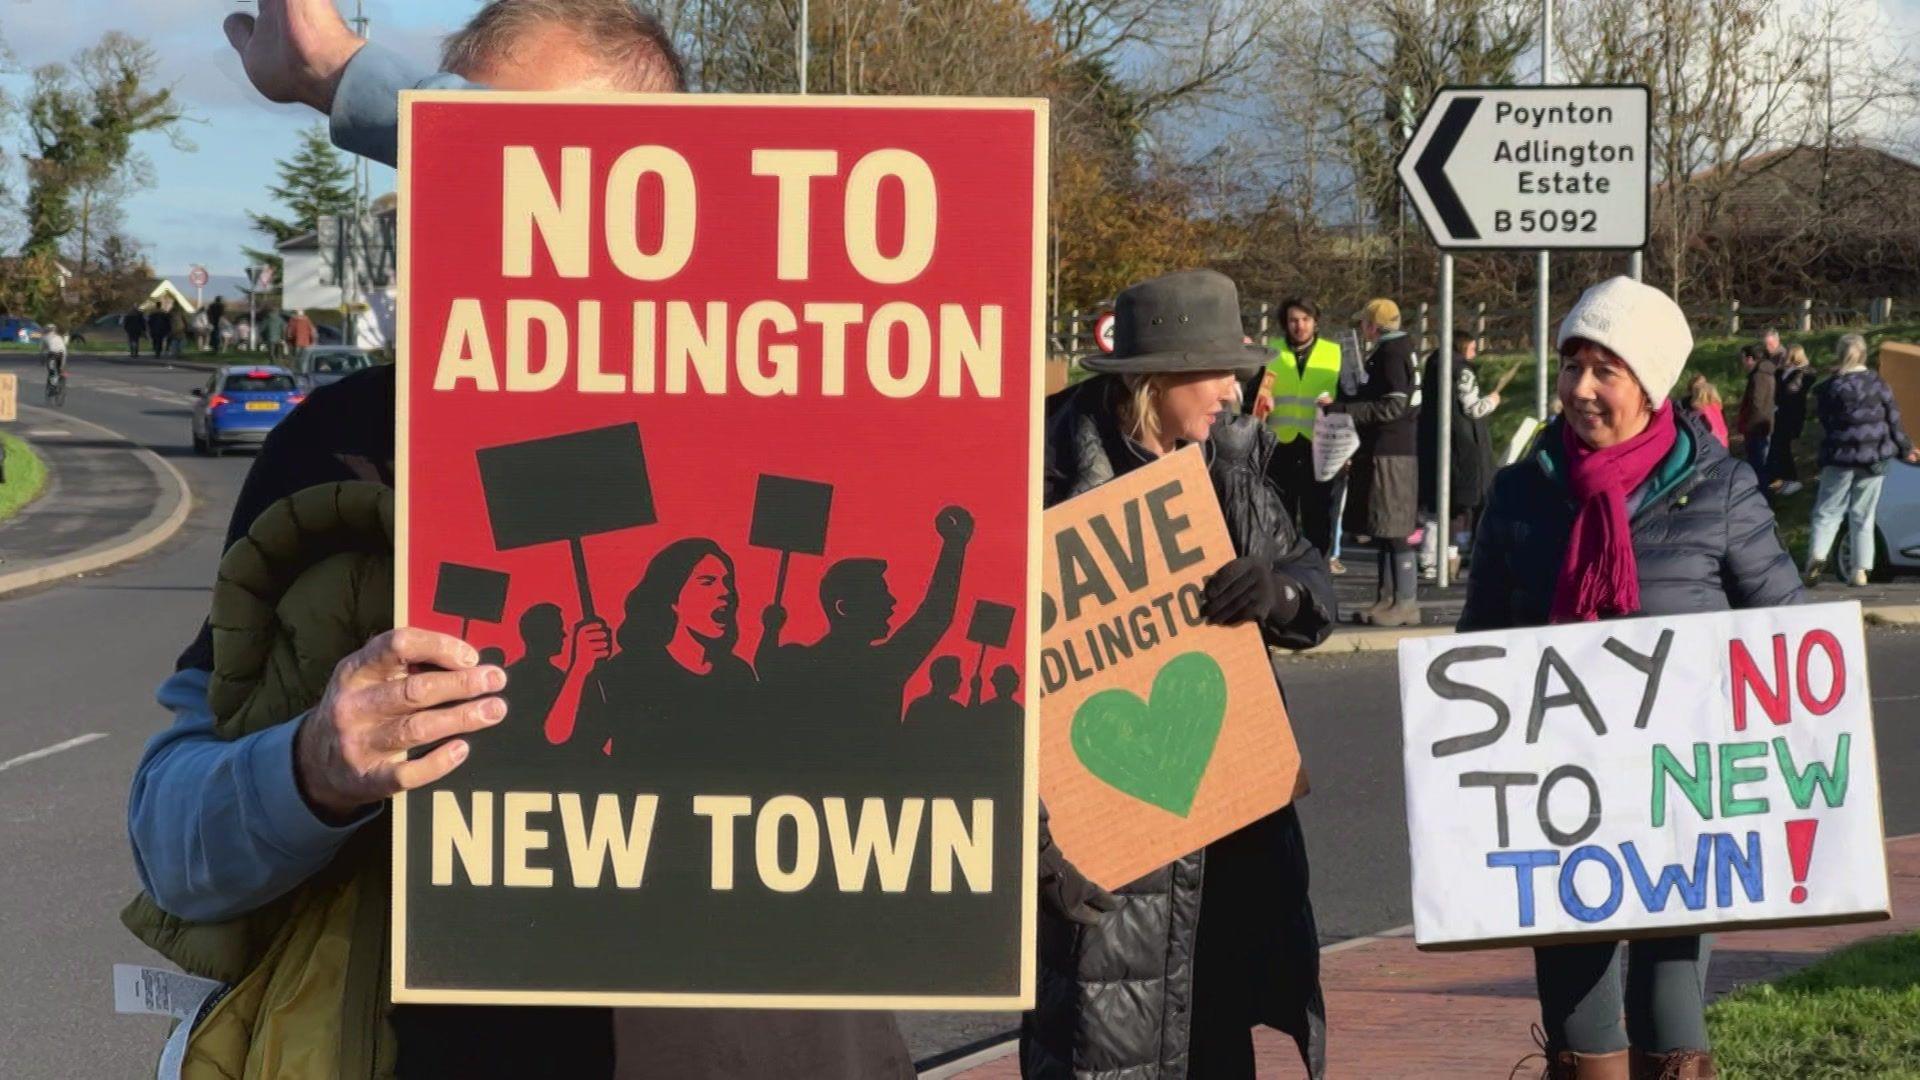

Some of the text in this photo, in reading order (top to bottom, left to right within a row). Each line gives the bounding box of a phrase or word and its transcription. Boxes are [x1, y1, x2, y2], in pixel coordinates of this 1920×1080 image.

[1493, 140, 1635, 167] Adlington
[1496, 101, 1613, 128] Poynton
[502, 144, 938, 284] NO TO
[1518, 171, 1611, 194] Estate
[1519, 209, 1598, 232] 5092
[433, 298, 1003, 399] ADLINGTON
[1039, 574, 1213, 699] DLINGTO
[1426, 628, 1847, 758] SAY NO
[1459, 733, 1851, 848] TO NEW
[431, 790, 994, 894] NEW TOWN
